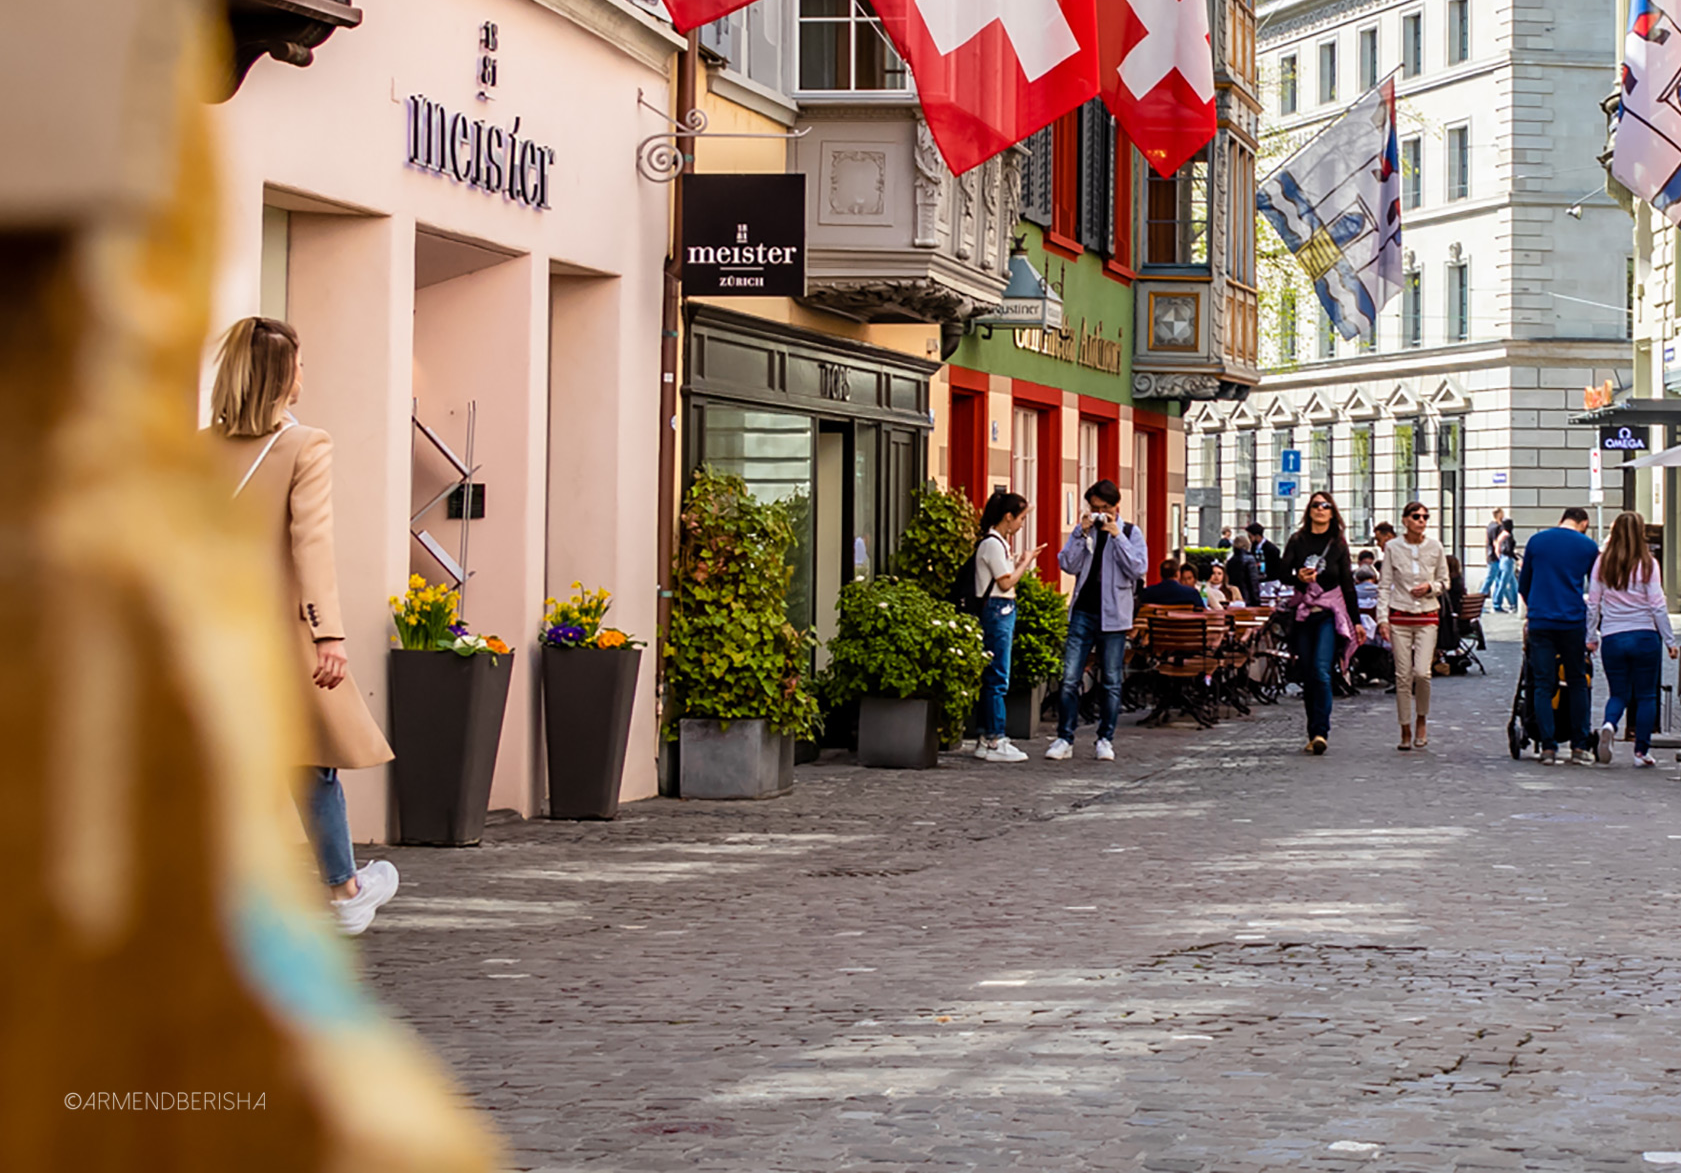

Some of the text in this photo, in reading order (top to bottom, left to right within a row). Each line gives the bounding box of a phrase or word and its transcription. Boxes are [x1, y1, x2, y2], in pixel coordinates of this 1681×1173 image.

[407, 94, 557, 210] meister
[687, 242, 797, 264] meister
[719, 275, 764, 287] ZÜRICH
[1604, 438, 1645, 449] OMEGA
